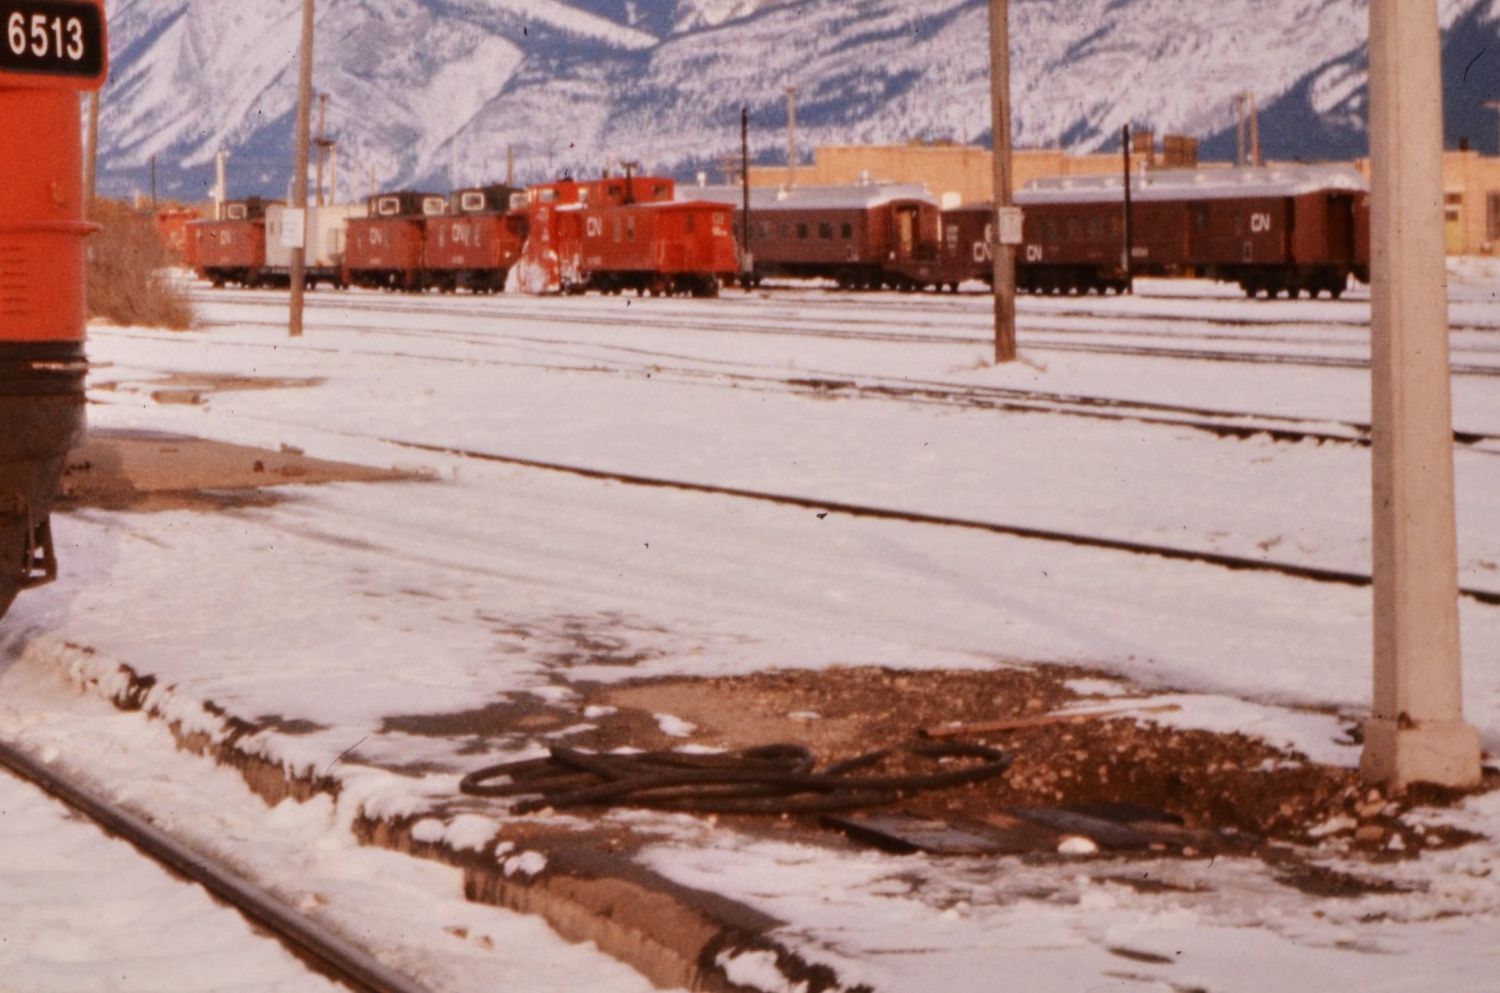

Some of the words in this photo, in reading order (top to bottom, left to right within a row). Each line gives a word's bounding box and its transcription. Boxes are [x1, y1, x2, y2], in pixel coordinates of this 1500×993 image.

[7, 11, 84, 61] 6513
[586, 216, 602, 238] CN
[1251, 213, 1271, 233] CN
[1026, 244, 1043, 262] CN
